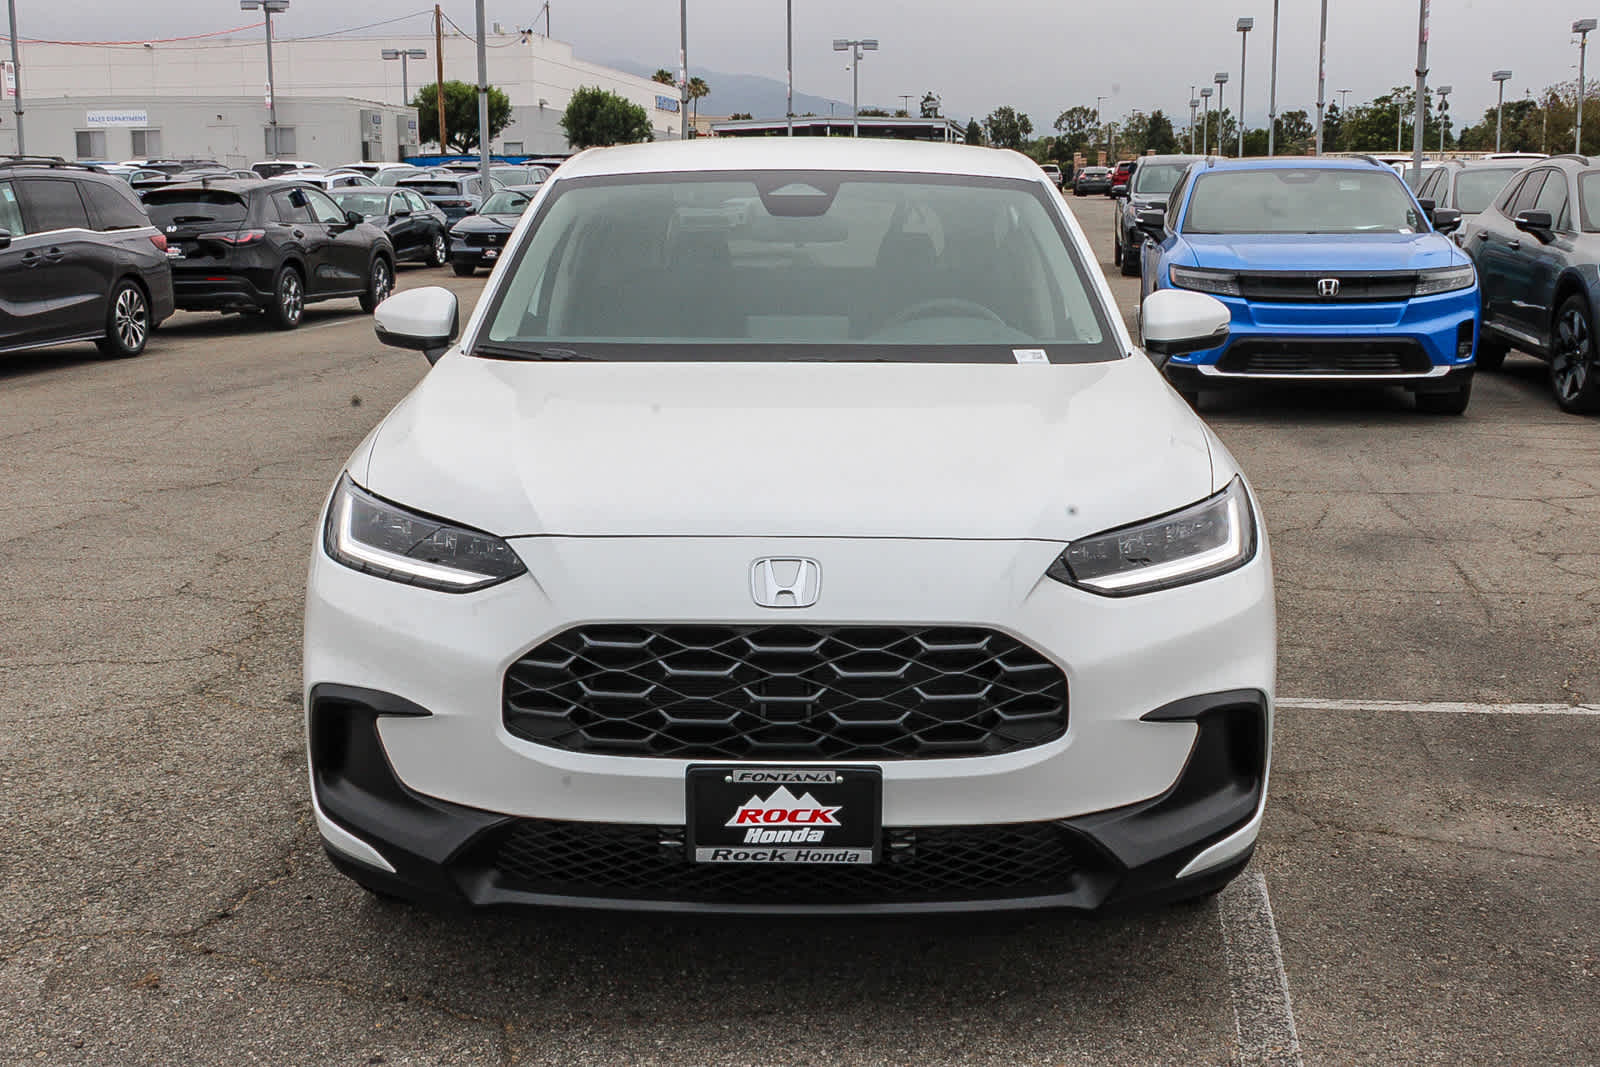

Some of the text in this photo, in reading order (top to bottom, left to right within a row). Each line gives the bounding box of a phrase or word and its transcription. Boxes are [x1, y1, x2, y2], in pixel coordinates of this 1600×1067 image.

[738, 772, 833, 782] FONTANA
[736, 808, 835, 824] ROCK
[743, 827, 825, 844] Honda
[711, 849, 861, 863] Rock Honda
